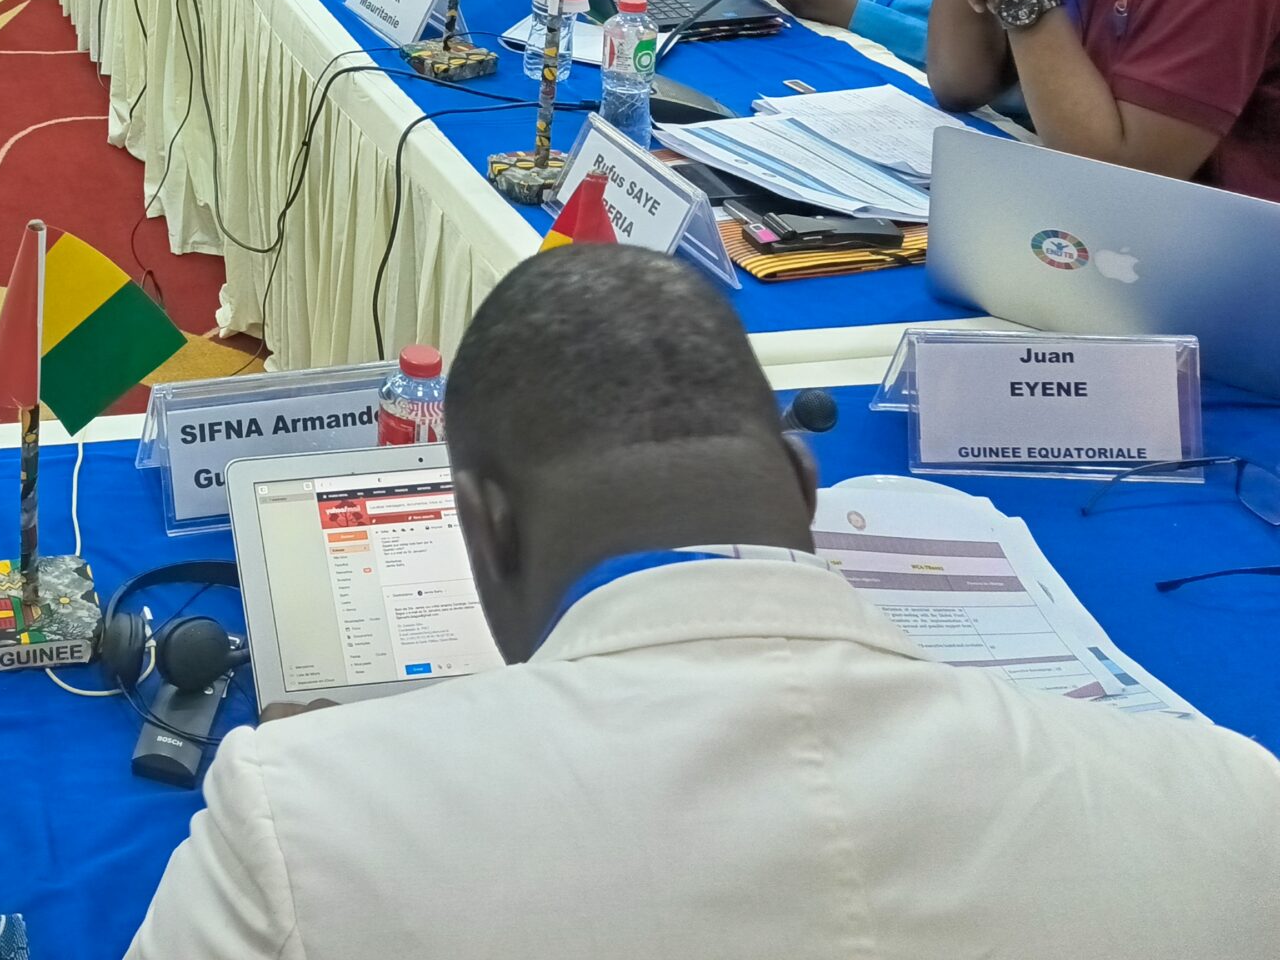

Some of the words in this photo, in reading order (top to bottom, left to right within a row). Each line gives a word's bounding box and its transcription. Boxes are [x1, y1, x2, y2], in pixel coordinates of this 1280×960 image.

[593, 153, 625, 189] Rufus
[625, 181, 661, 217] SAYE
[1046, 247, 1063, 257] END
[1063, 251, 1074, 260] TB
[1020, 347, 1075, 364] Juan
[1009, 380, 1088, 398] EYENE
[180, 417, 264, 445] SIFNA
[958, 445, 1022, 459] GUINEE
[1026, 445, 1148, 460] EQUATORIALE
[194, 467, 226, 490] Gu
[0, 643, 84, 668] GUINEE
[156, 734, 183, 748] BOSCH
